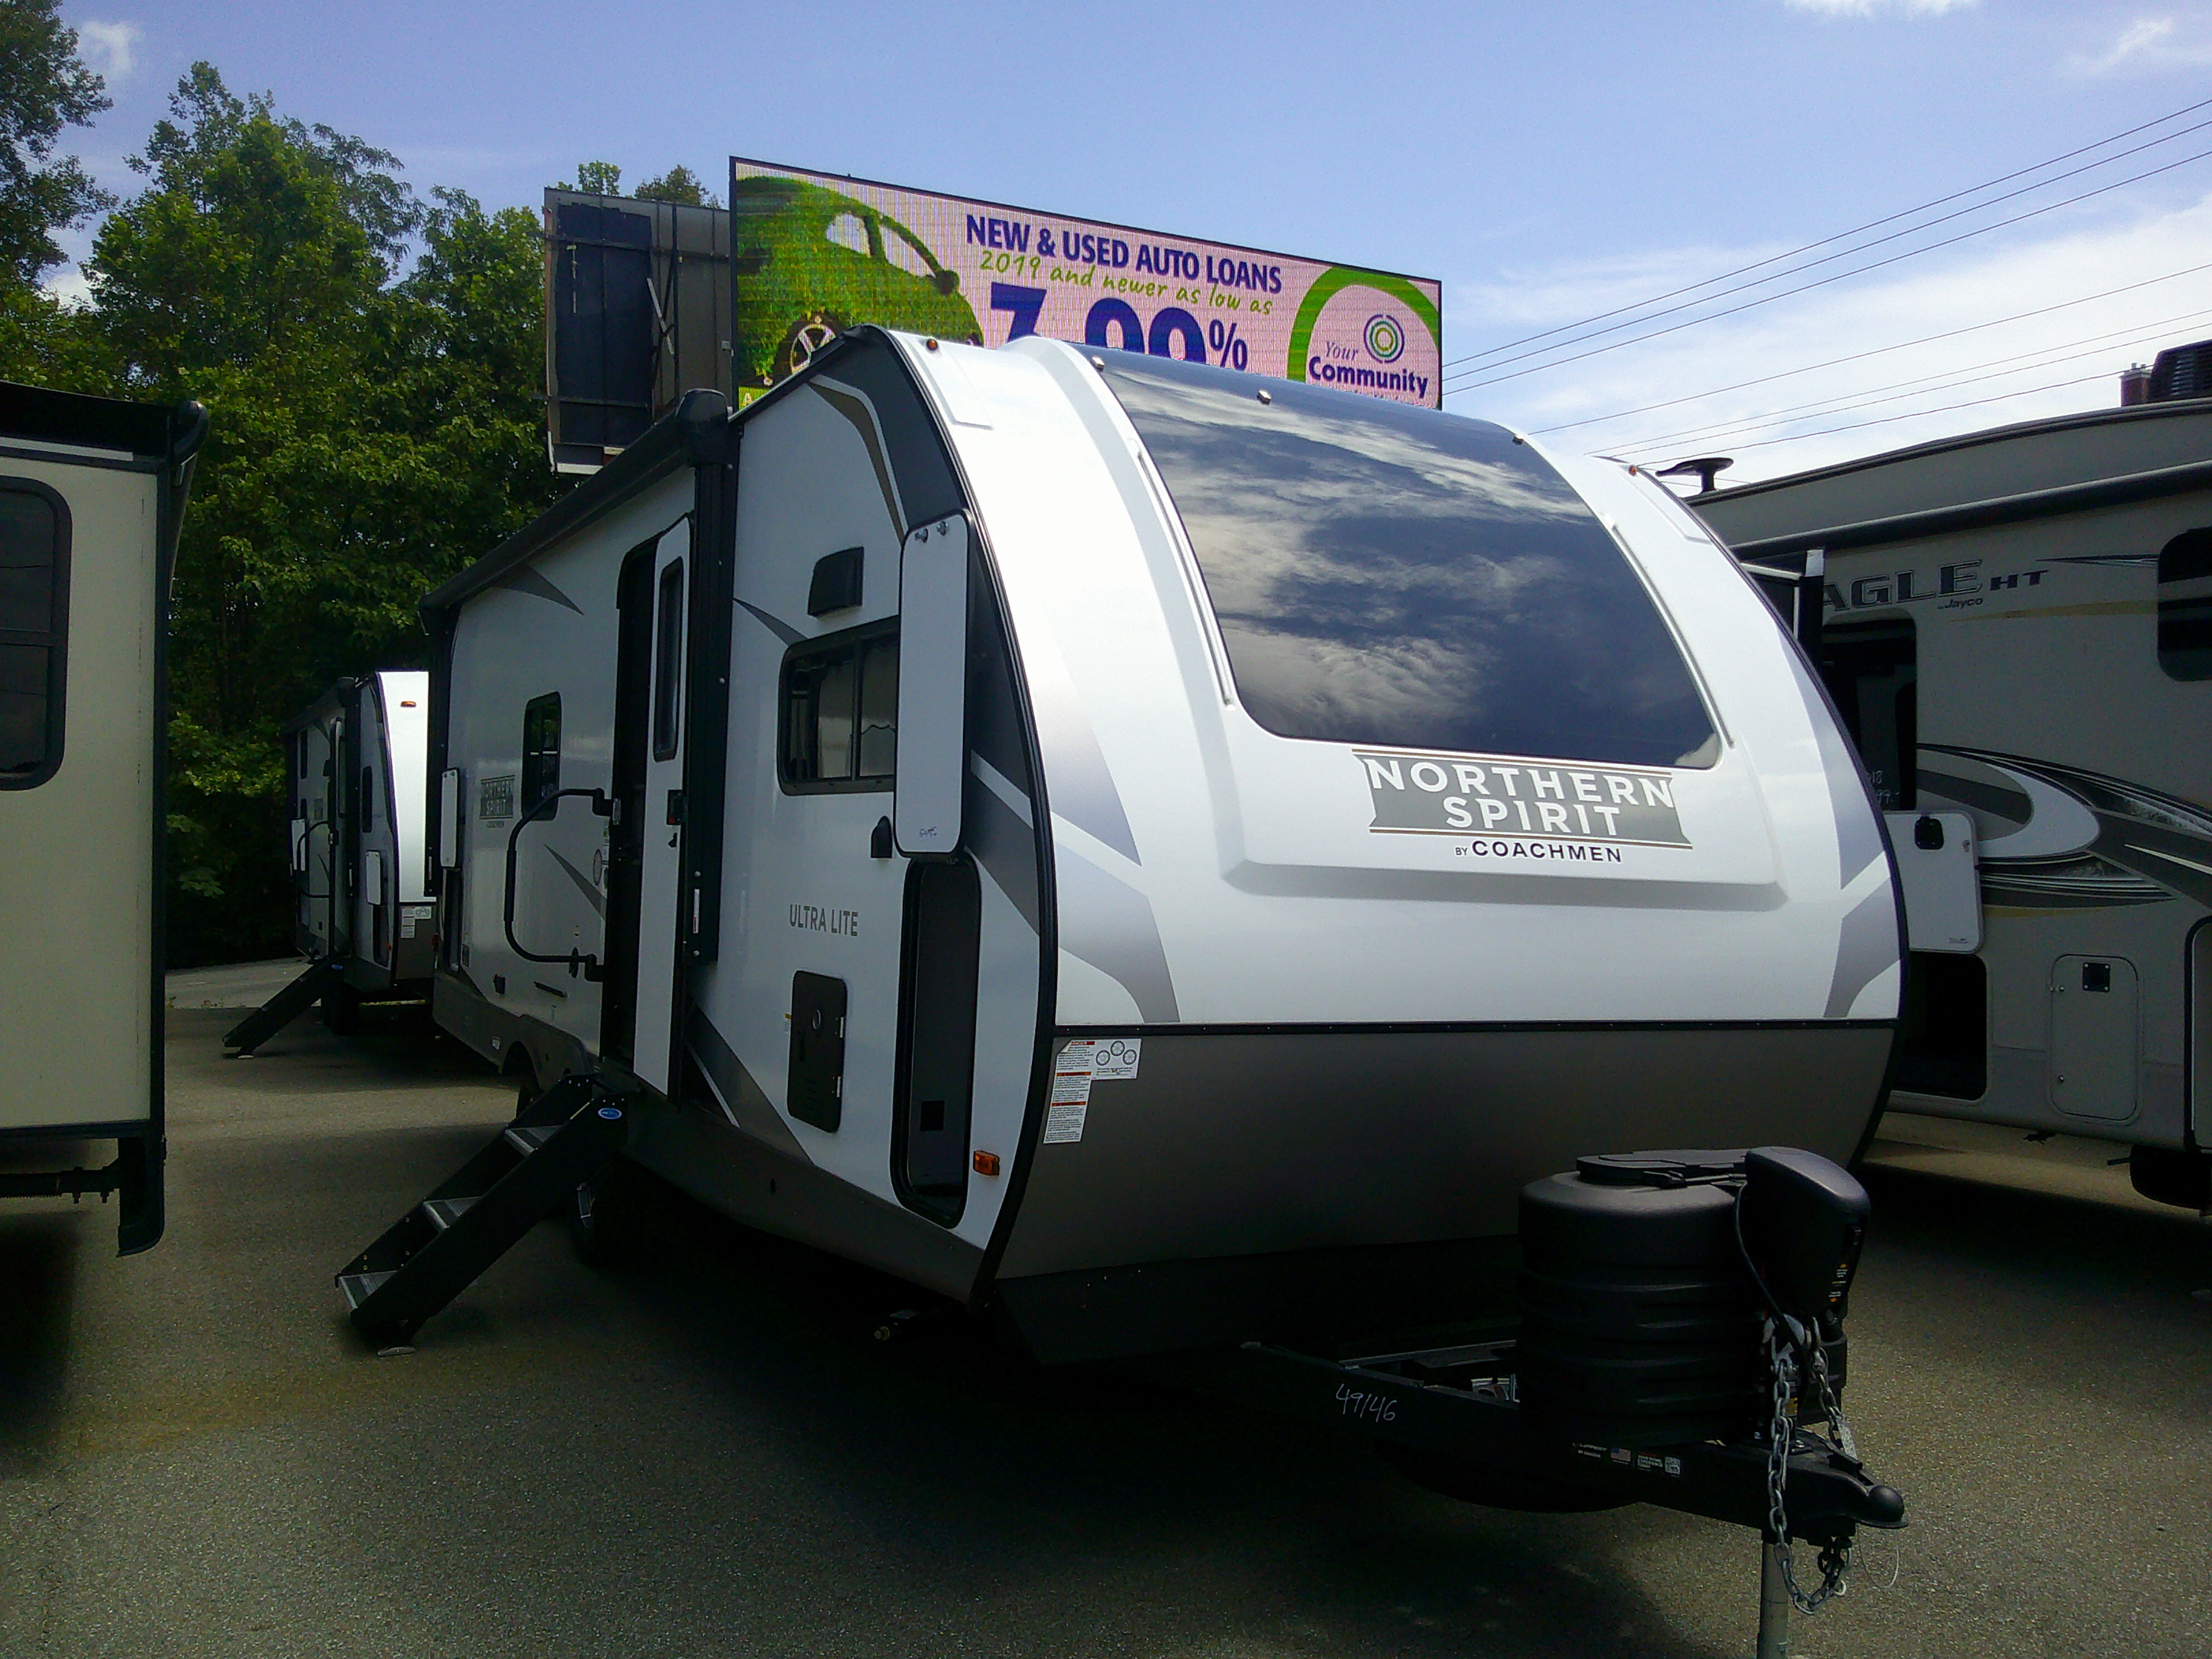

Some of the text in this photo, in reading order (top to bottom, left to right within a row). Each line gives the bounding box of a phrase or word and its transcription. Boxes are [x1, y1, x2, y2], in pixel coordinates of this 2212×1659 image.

[967, 214, 1282, 294] NEW & USED AUTO LOANS
[980, 250, 1272, 315] 2019 and newer as low as
[1326, 341, 1359, 360] Your
[1309, 356, 1428, 399] Community
[1823, 559, 2048, 611] AGLE HT
[1362, 758, 1674, 808] NORTHERN
[1442, 796, 1621, 836] SPIRIT
[1455, 840, 1622, 863] BY COACHMEN
[790, 904, 859, 937] ULTRA LITE
